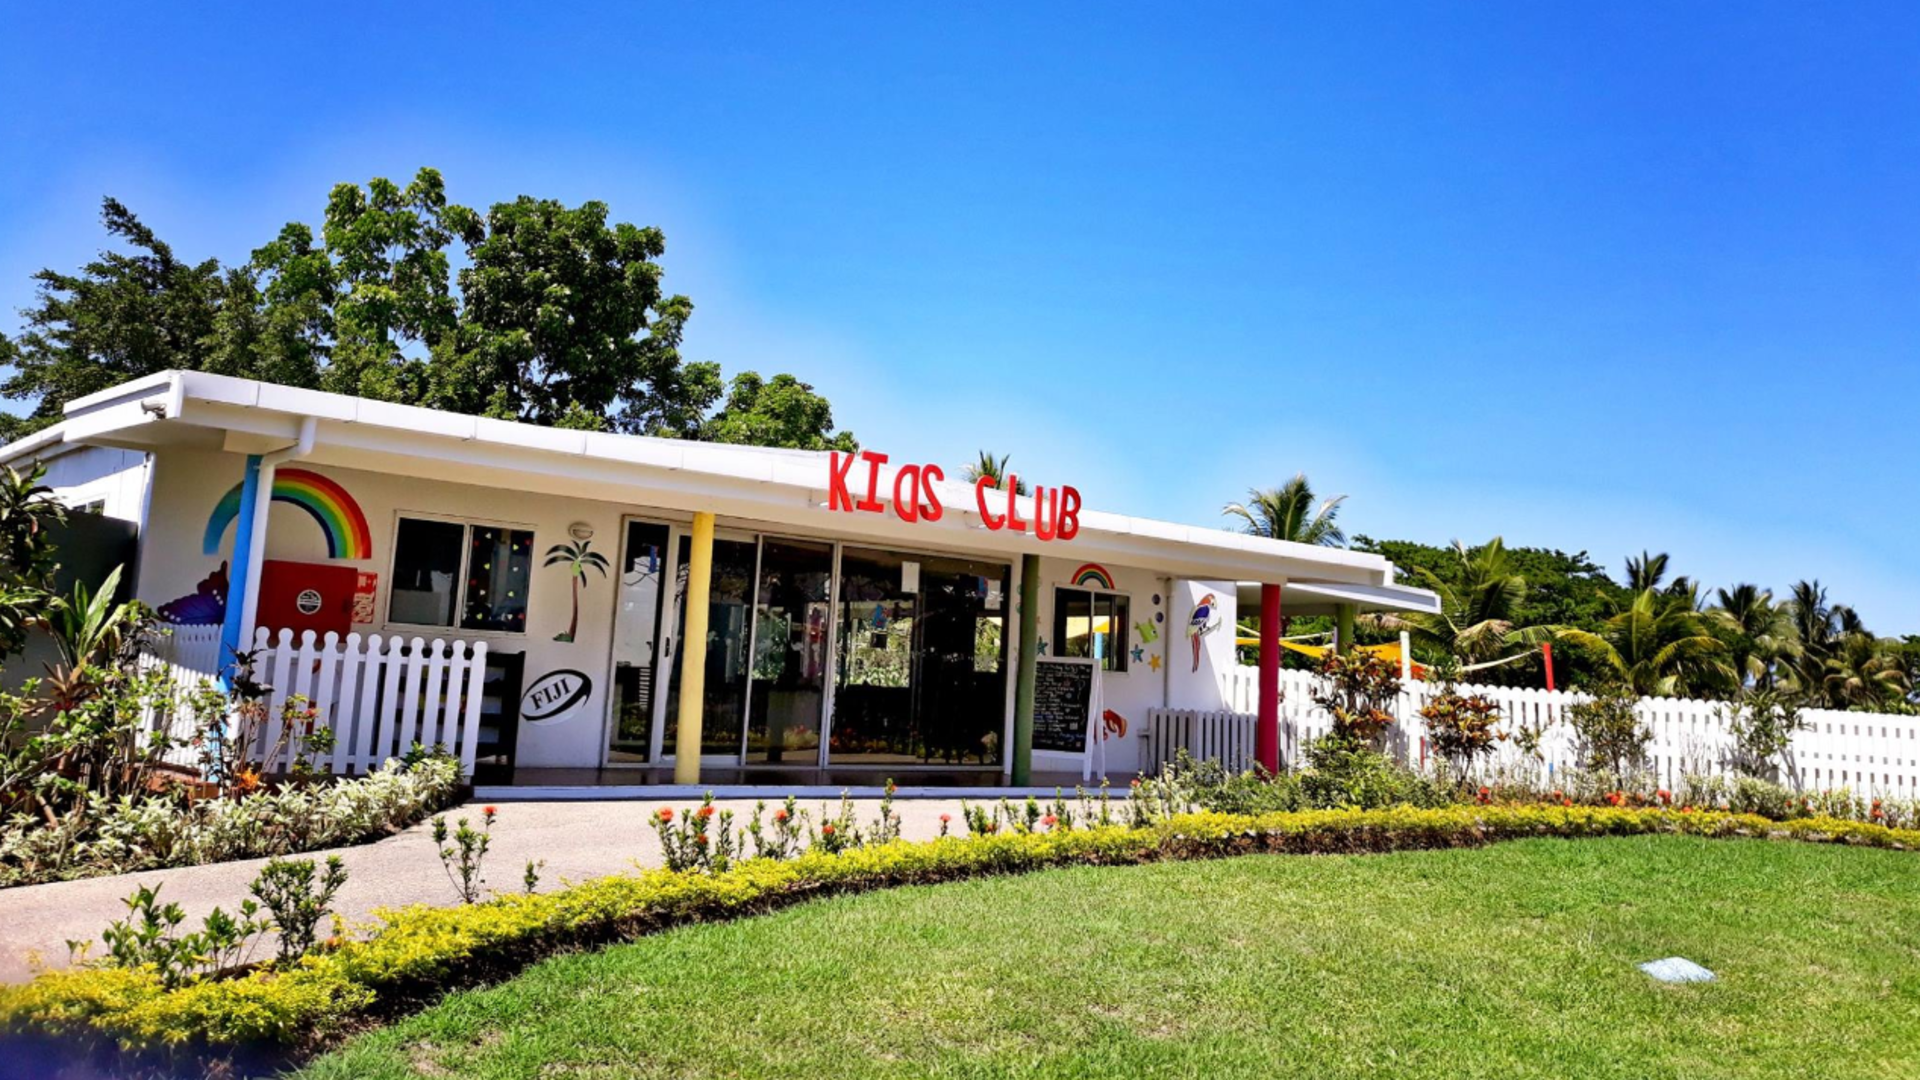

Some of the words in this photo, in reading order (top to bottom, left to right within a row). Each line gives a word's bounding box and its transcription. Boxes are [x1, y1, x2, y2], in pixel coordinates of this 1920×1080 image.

[828, 451, 944, 523] KIDS
[976, 475, 1082, 541] CLUB
[529, 677, 571, 710] FIJI
